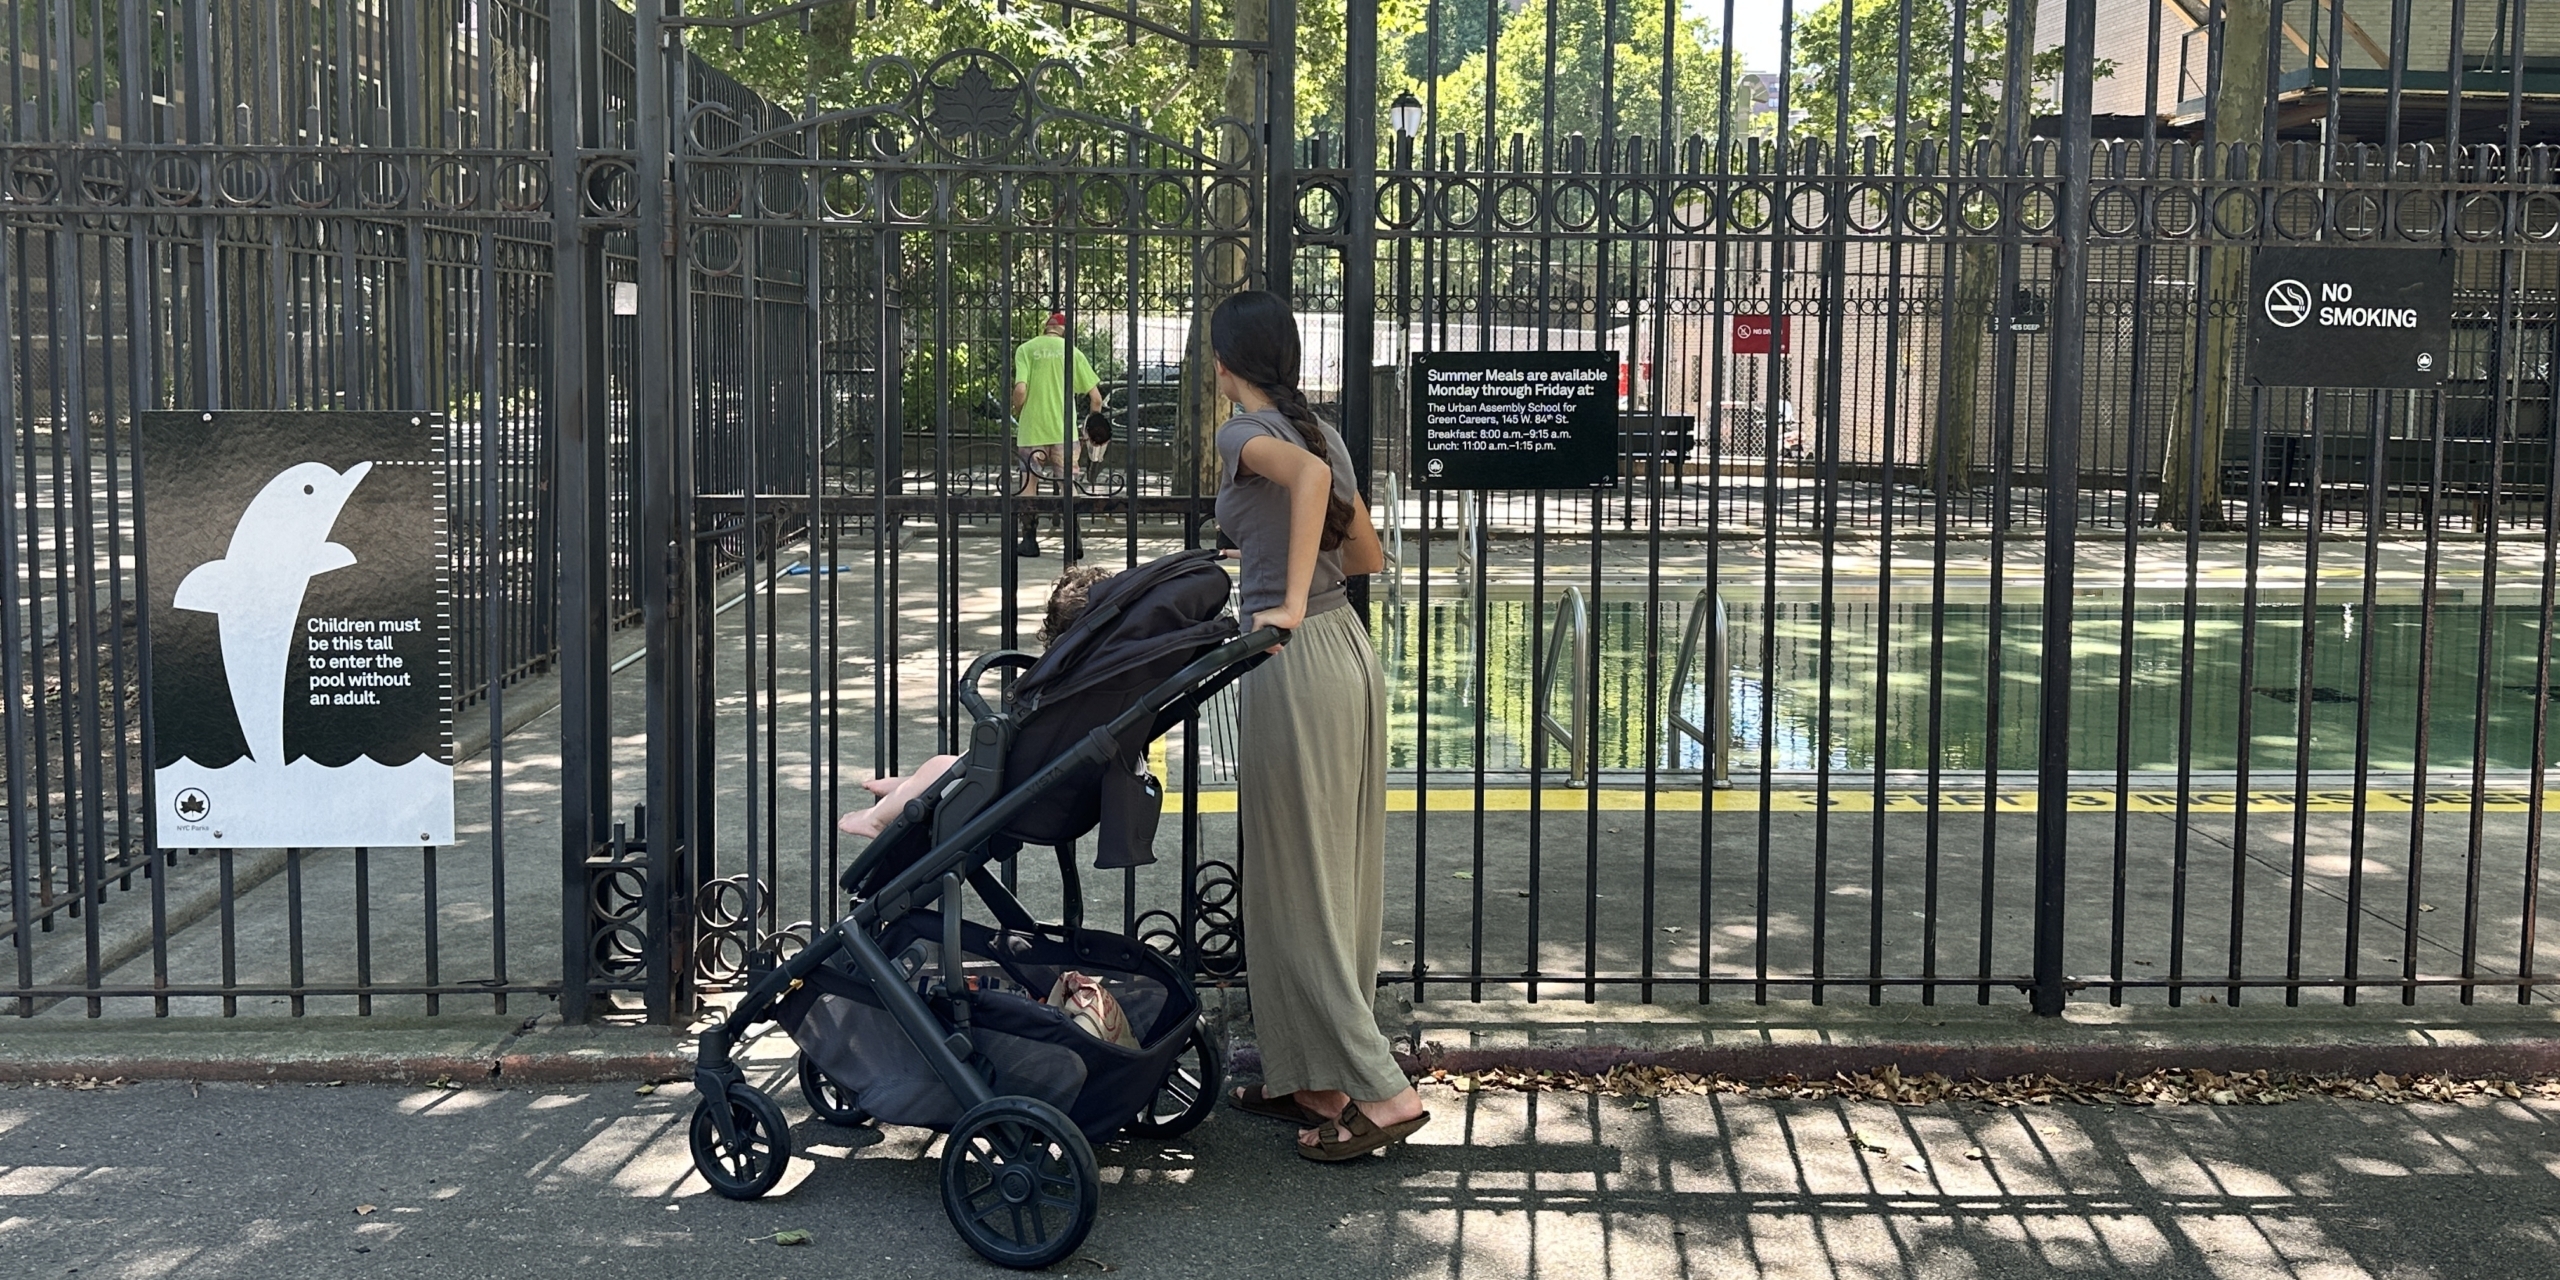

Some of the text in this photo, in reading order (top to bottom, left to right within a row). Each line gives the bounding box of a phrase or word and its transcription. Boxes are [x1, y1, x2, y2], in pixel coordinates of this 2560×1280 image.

[2321, 283, 2353, 303] NO
[2319, 306, 2417, 328] SMOKING
[1427, 369, 1608, 382] Summer Meals are available
[1428, 384, 1595, 399] Monday through Friday at:
[1428, 402, 1577, 414] The Urban Assembly School for
[1427, 414, 1569, 426] Green Careers, 145 W. 84th St.
[1427, 429, 1572, 439] Breakfast: 8:00 a.m.–9:15 a.m.
[1427, 441, 1556, 453] Lunch: 11:00 a.m.–1:15 p.m.
[307, 617, 422, 633] Children must
[308, 635, 394, 651] be this tall
[308, 653, 403, 669] to enter the
[309, 672, 412, 691] pool without
[309, 690, 381, 706] an adult.
[1025, 766, 1064, 794] VISTA
[1796, 794, 1840, 806] 3
[1871, 793, 2021, 806] FEET
[2065, 794, 2107, 806] 3
[2136, 793, 2365, 806] INCHES
